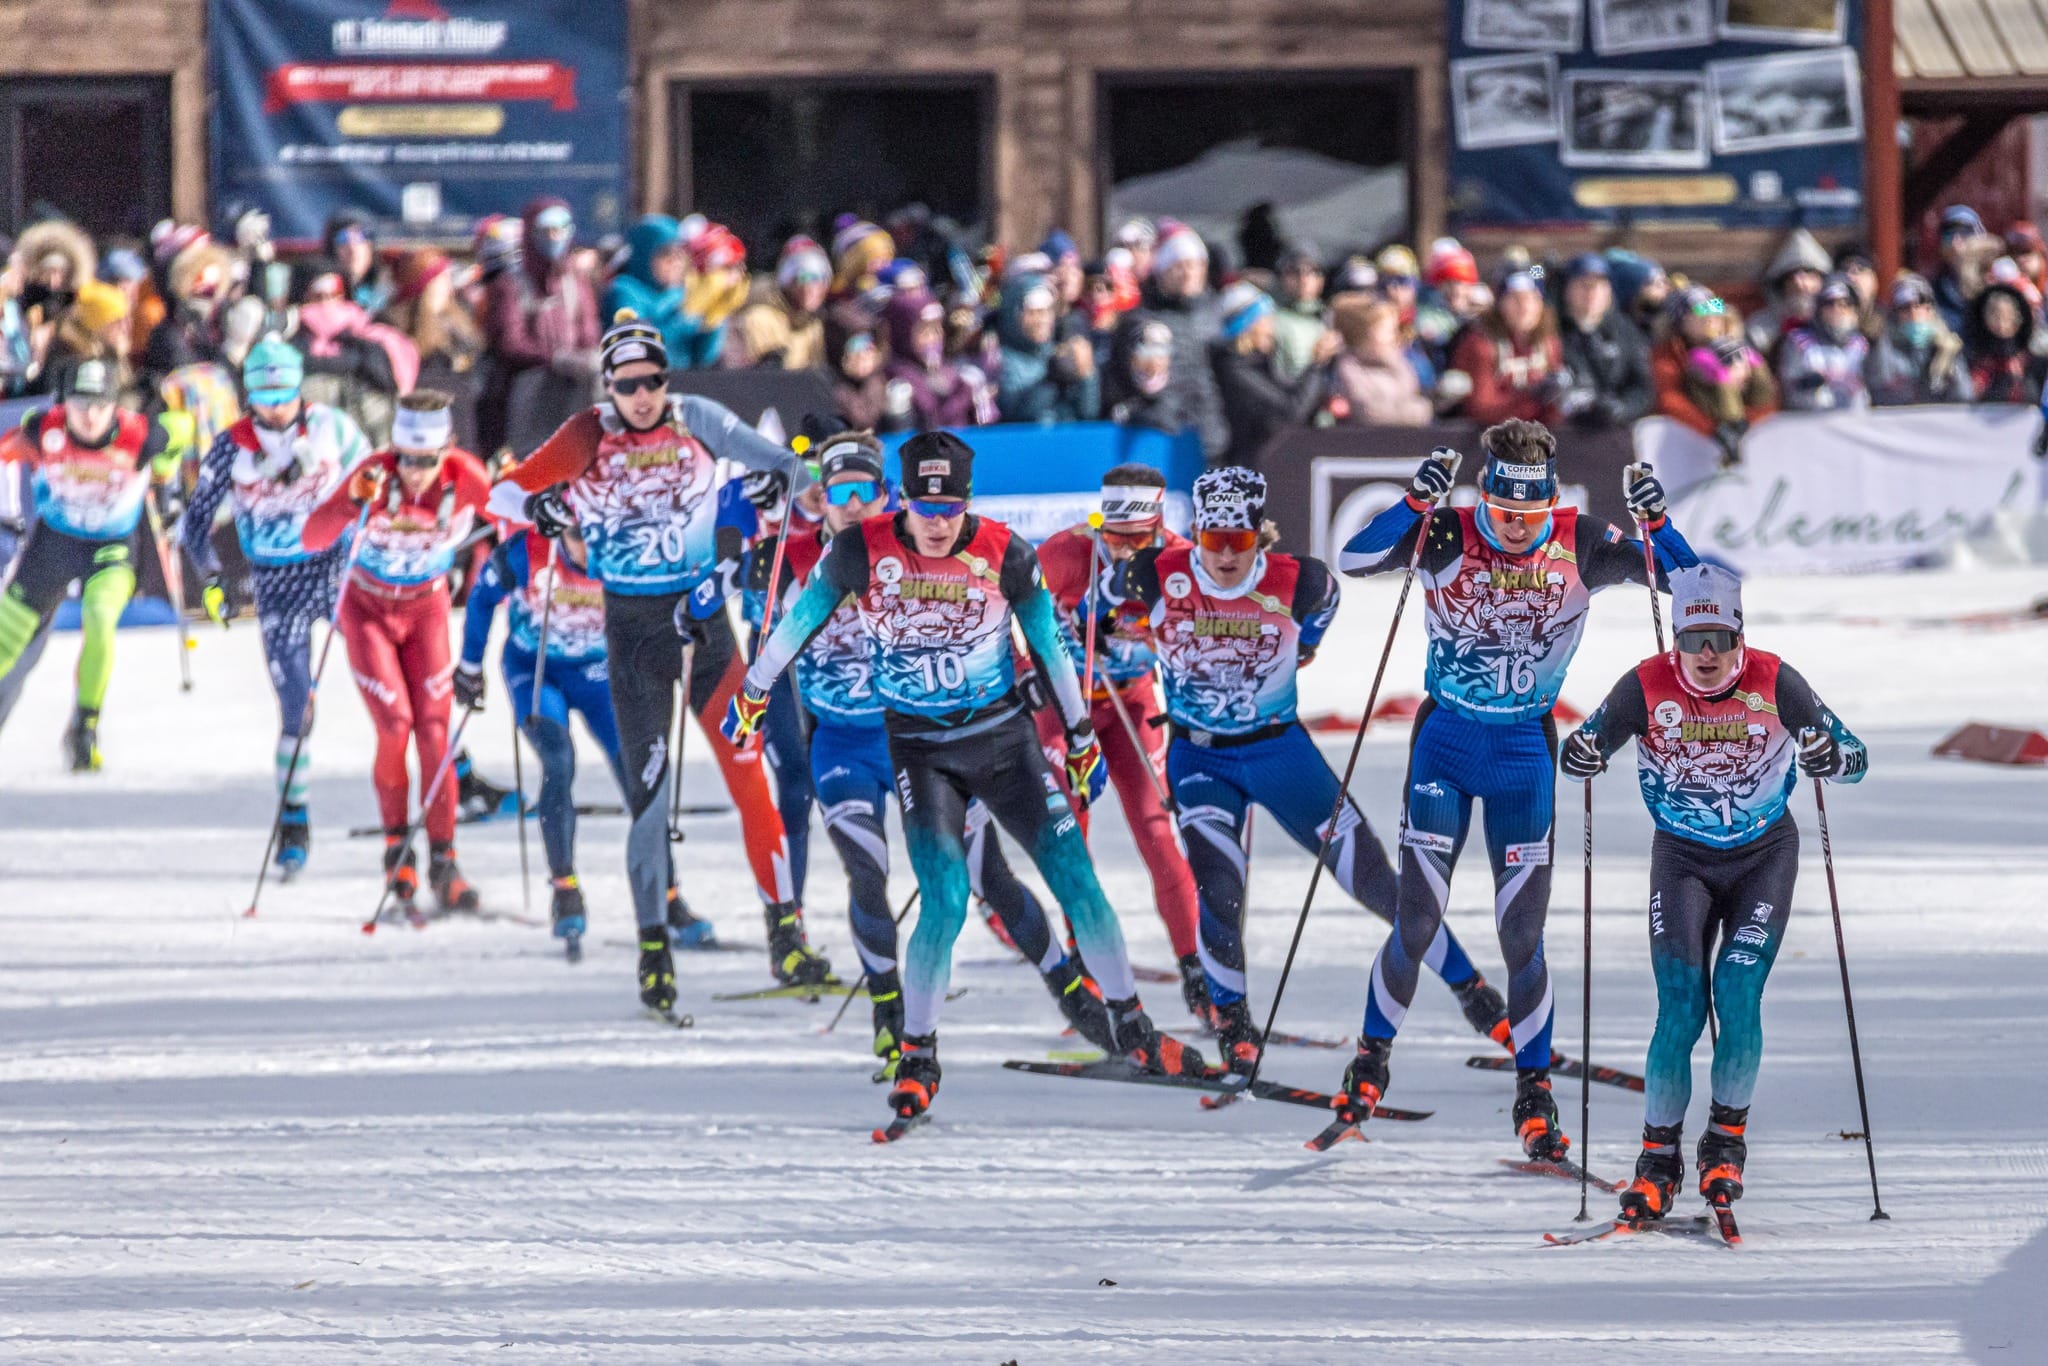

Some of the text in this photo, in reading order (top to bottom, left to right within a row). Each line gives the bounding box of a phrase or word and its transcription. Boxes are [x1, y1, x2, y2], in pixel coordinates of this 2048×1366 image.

[1508, 465, 1545, 473] COFFMAN
[1208, 494, 1233, 503] POW
[638, 525, 685, 567] 20
[886, 569, 894, 579] 2
[1490, 568, 1548, 590] BIRKIE
[900, 579, 968, 602] BIRKIE
[1176, 584, 1182, 594] 1
[1194, 608, 1260, 620] slumberland
[1500, 608, 1554, 616] ARIENS
[1685, 604, 1720, 617] BIRKIE
[1194, 618, 1262, 638] BIRKIE
[844, 662, 872, 698] 2
[912, 652, 965, 692] 10
[1489, 655, 1536, 695] 16
[1665, 713, 1673, 724] 5
[1682, 711, 1746, 723] slumberland
[1681, 722, 1749, 743] BIRKIE
[897, 767, 915, 812] TEAM
[1692, 774, 1746, 785] DAVID NORRIS
[1711, 797, 1733, 826] 1
[1650, 891, 1665, 937] TEAM
